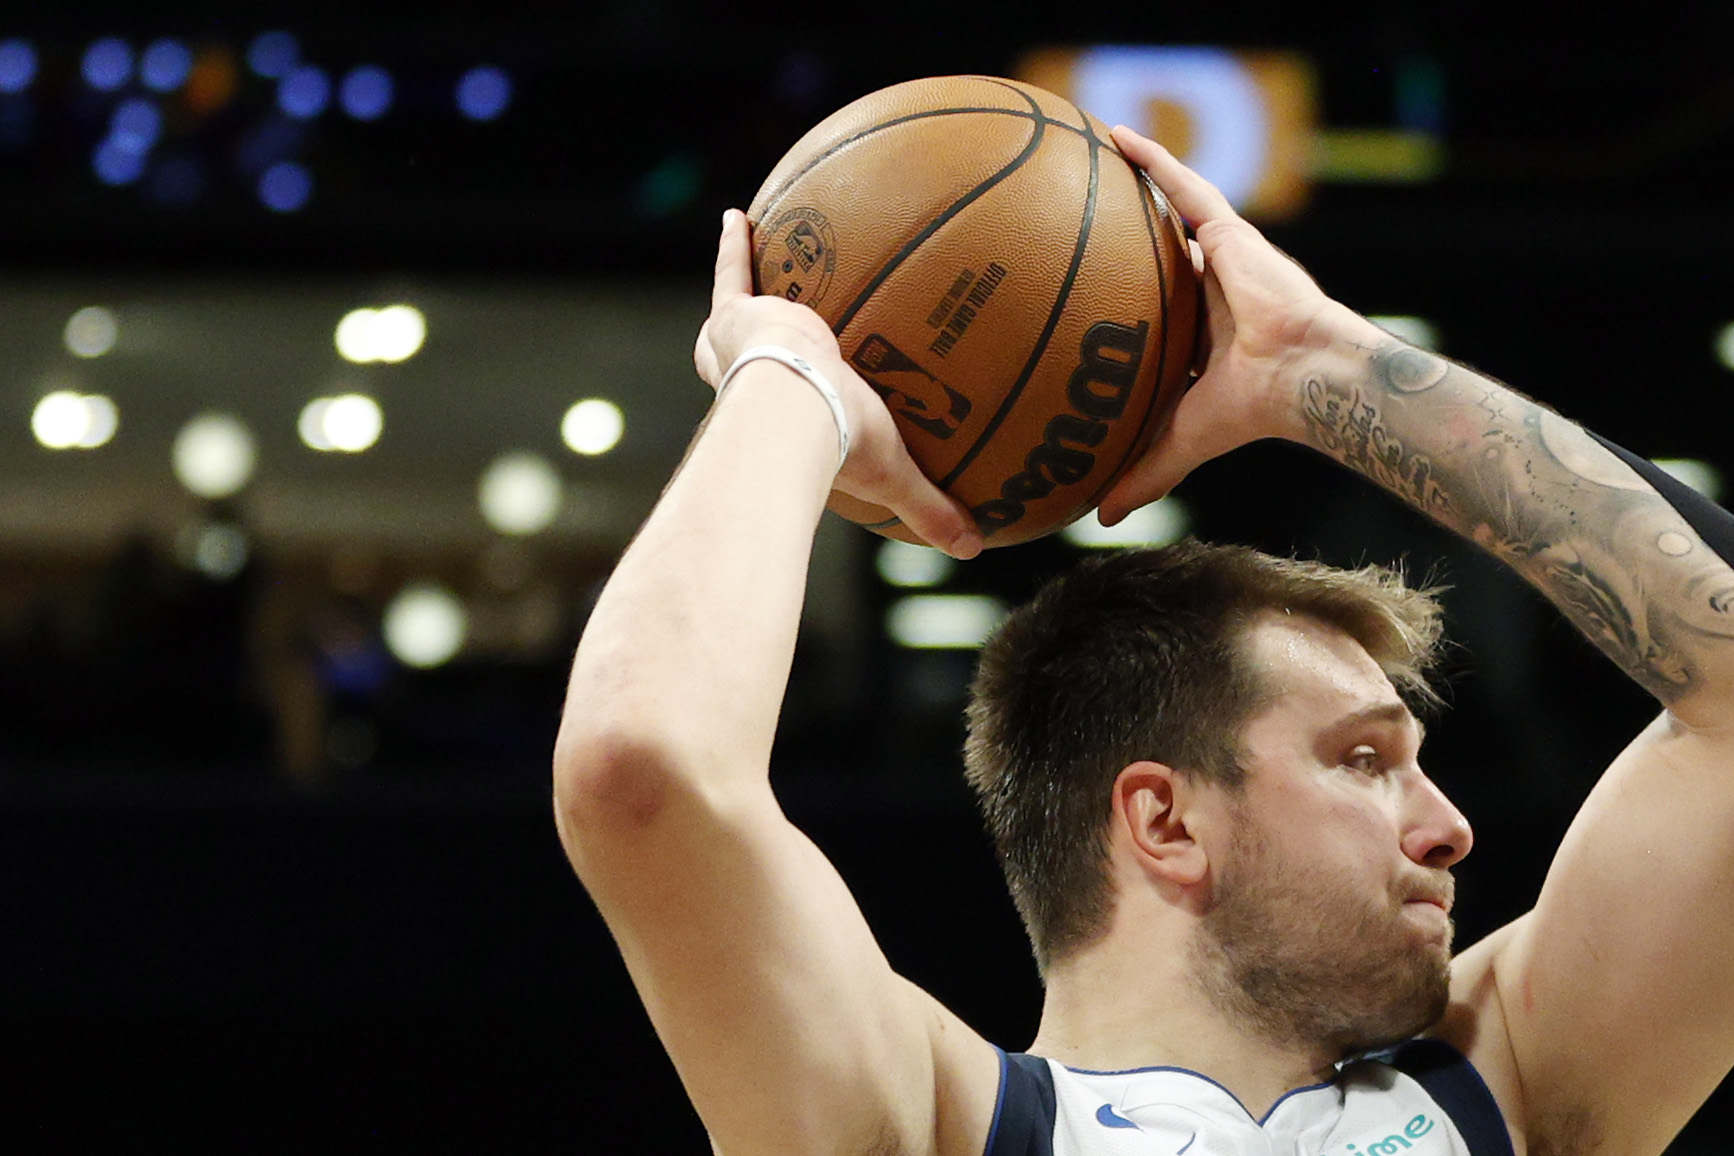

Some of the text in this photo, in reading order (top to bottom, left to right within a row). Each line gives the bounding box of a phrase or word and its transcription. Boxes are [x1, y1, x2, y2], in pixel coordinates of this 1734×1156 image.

[966, 262, 1007, 310] OFFICIAL
[946, 303, 978, 338] GAME
[929, 330, 958, 359] BALL
[979, 320, 1148, 536] Wilso
